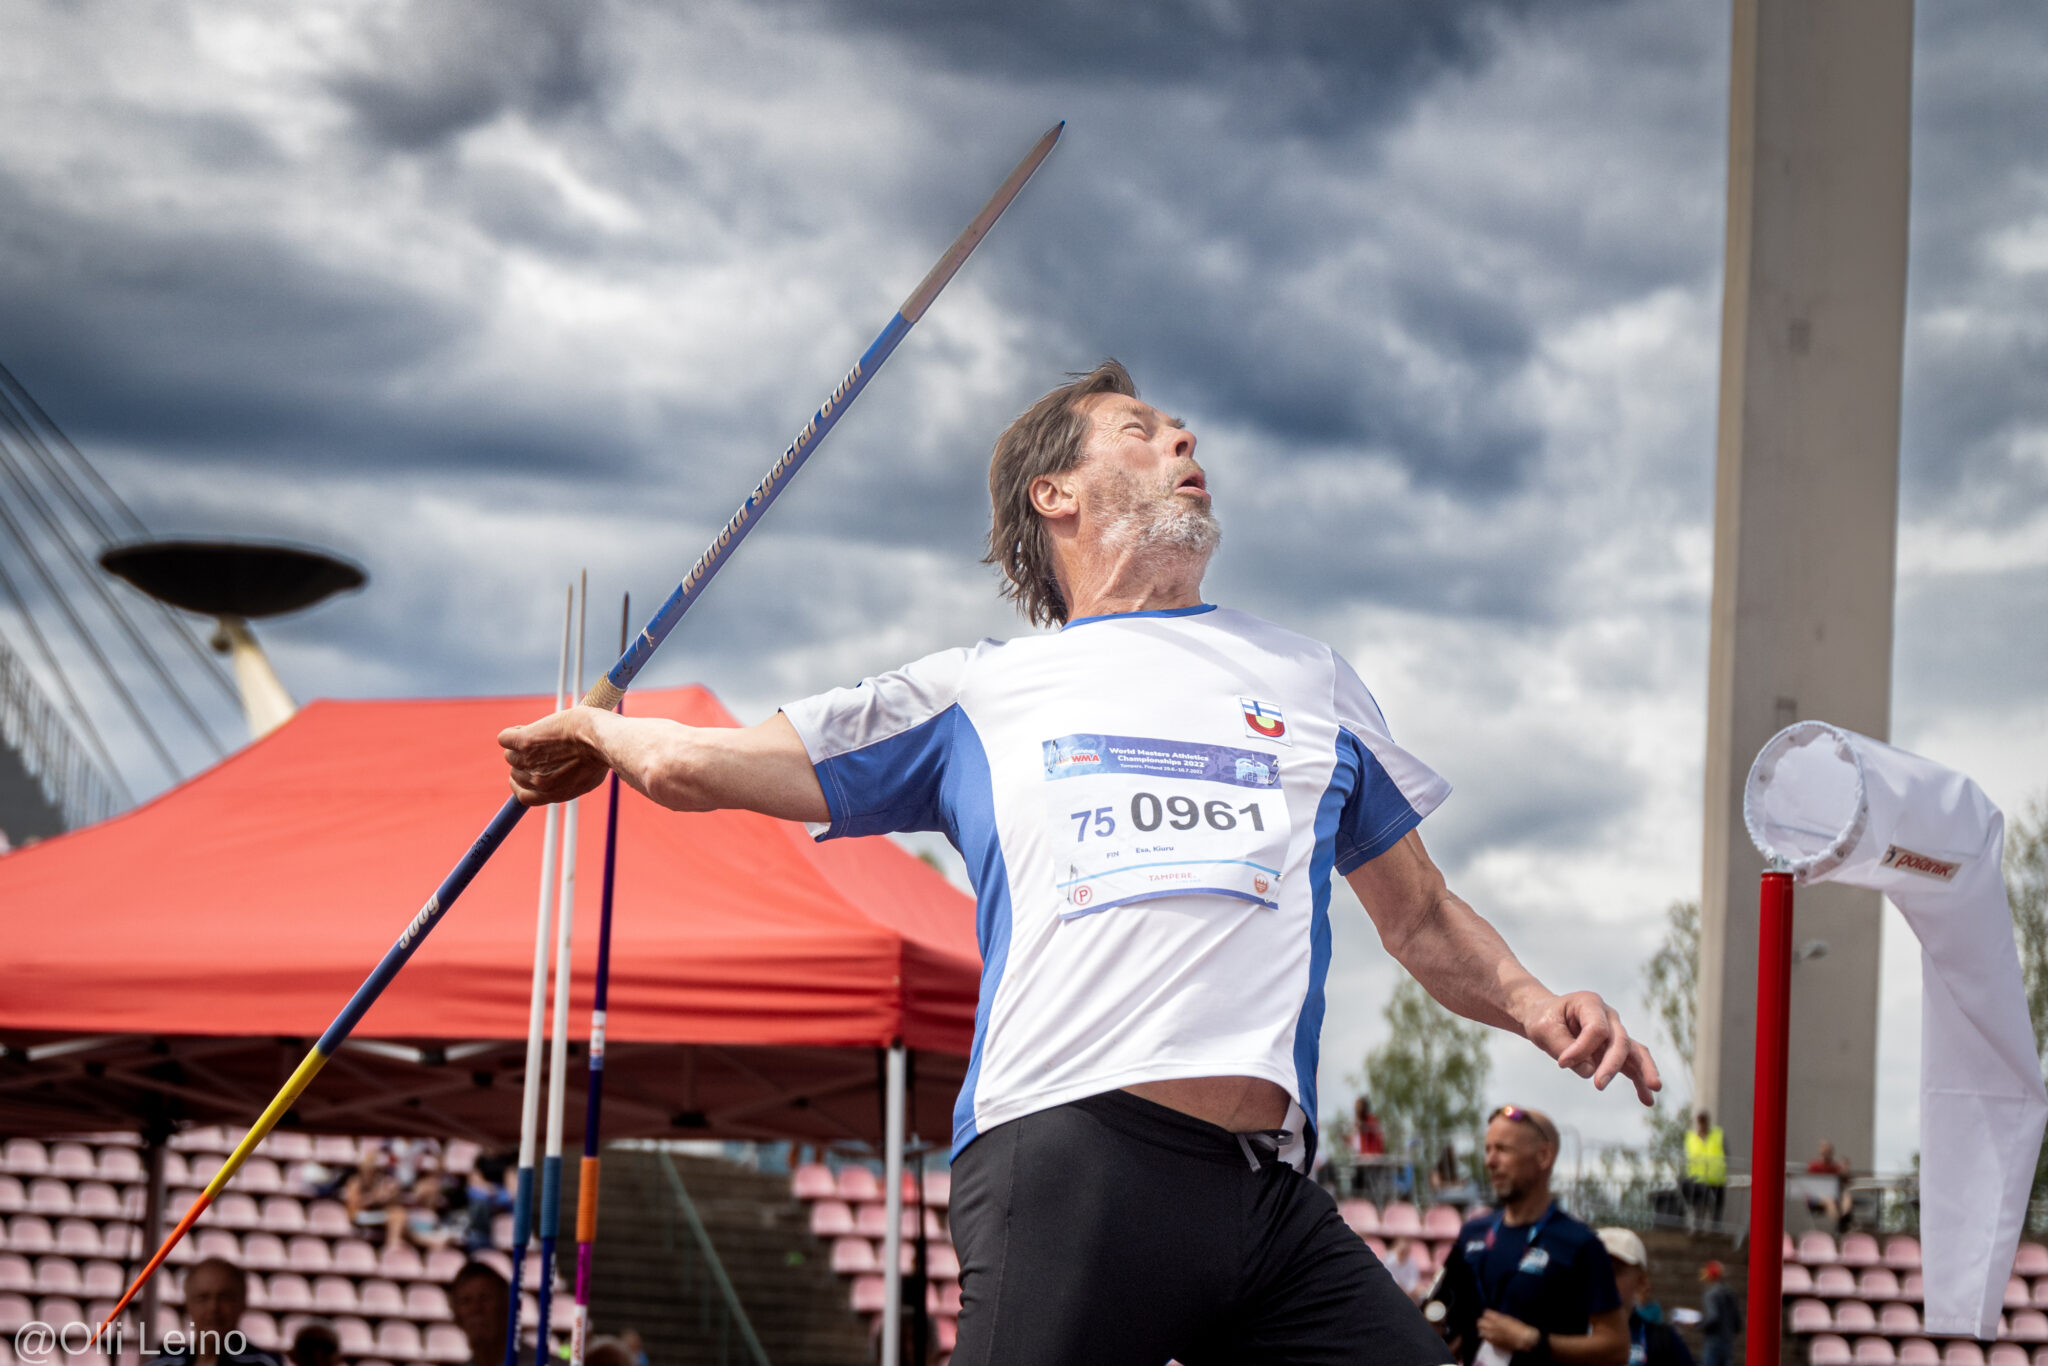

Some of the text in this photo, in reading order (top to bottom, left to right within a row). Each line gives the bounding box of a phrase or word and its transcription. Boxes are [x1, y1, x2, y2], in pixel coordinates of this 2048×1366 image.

[1071, 753, 1100, 763] WMA
[1108, 747, 1209, 762] World Masters Athletics
[1117, 755, 1205, 768] Championships 2022
[1070, 792, 1265, 843] 75 0961
[1106, 850, 1120, 859] FIN
[1152, 845, 1175, 853] Kiuru
